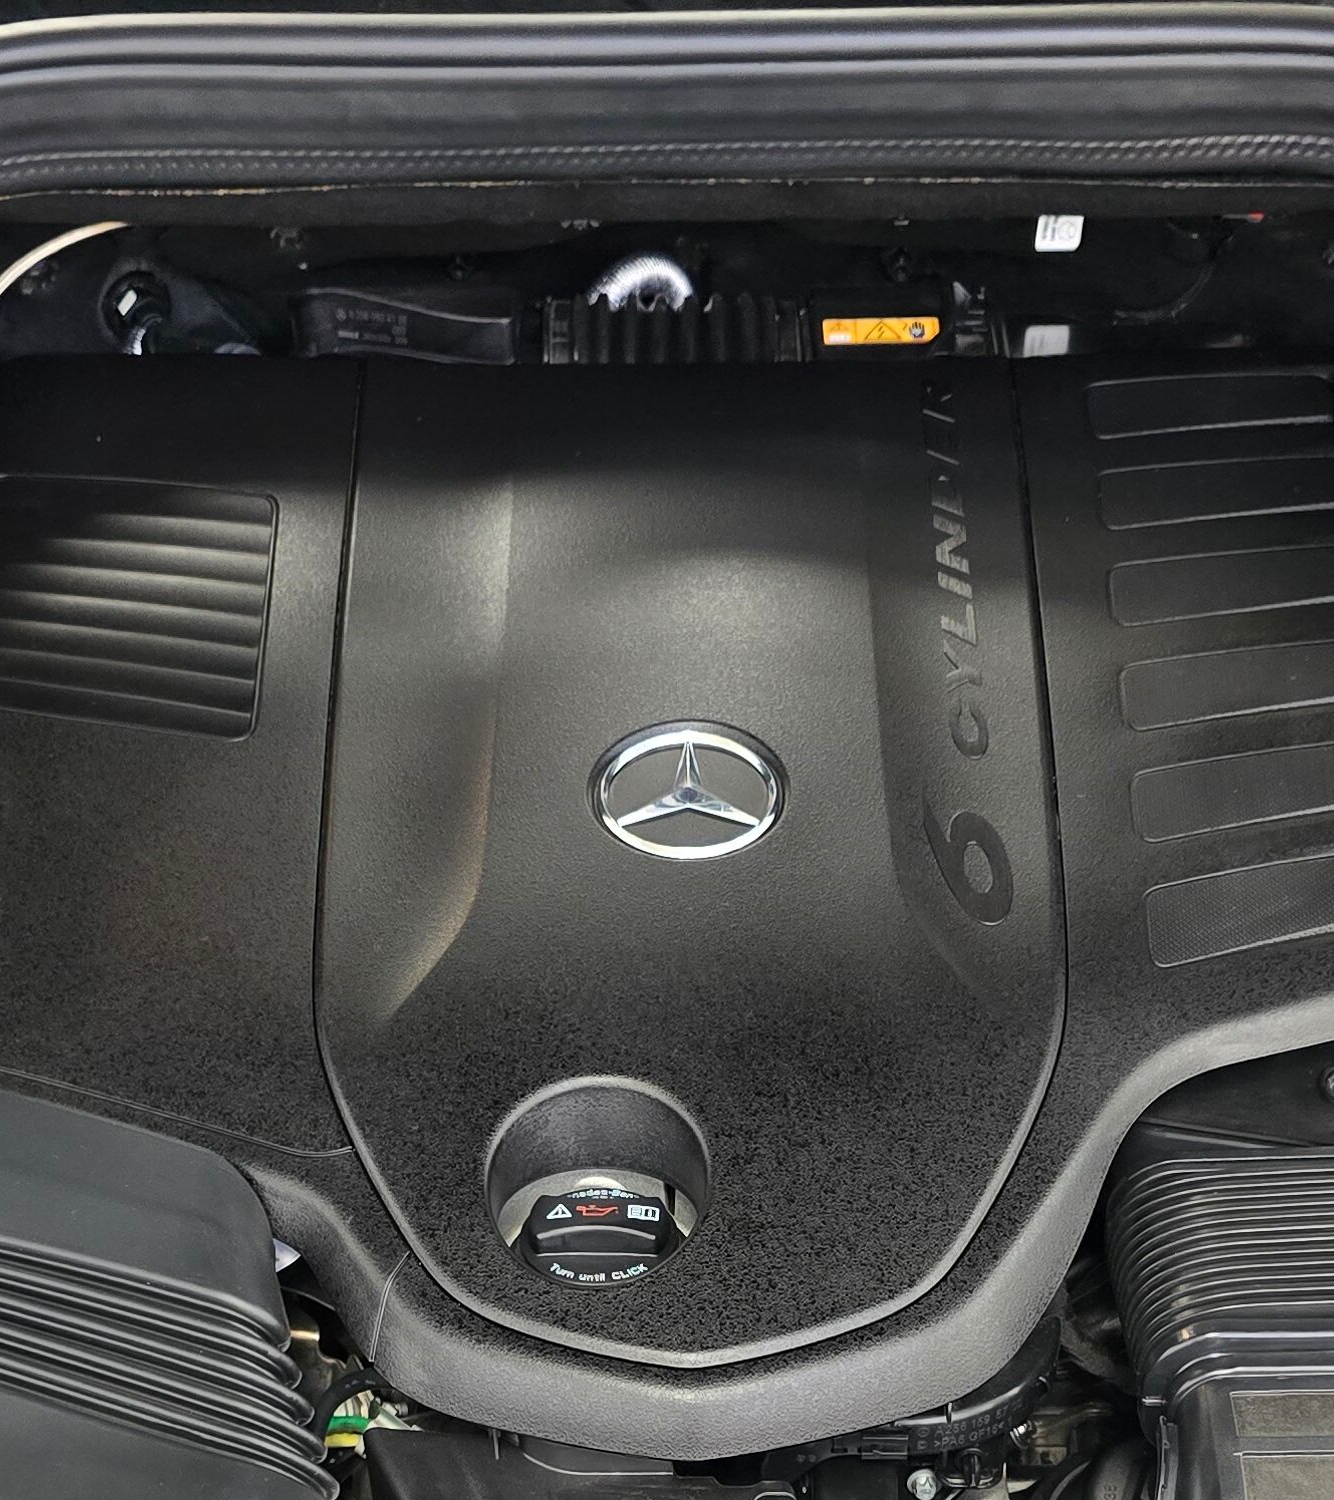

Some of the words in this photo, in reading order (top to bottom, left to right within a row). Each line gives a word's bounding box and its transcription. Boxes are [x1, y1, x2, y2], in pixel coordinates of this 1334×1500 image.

[923, 784, 1014, 927] 6
[549, 1262, 575, 1279] Turn
[578, 1273, 606, 1282] until
[611, 1262, 649, 1280] CLICK
